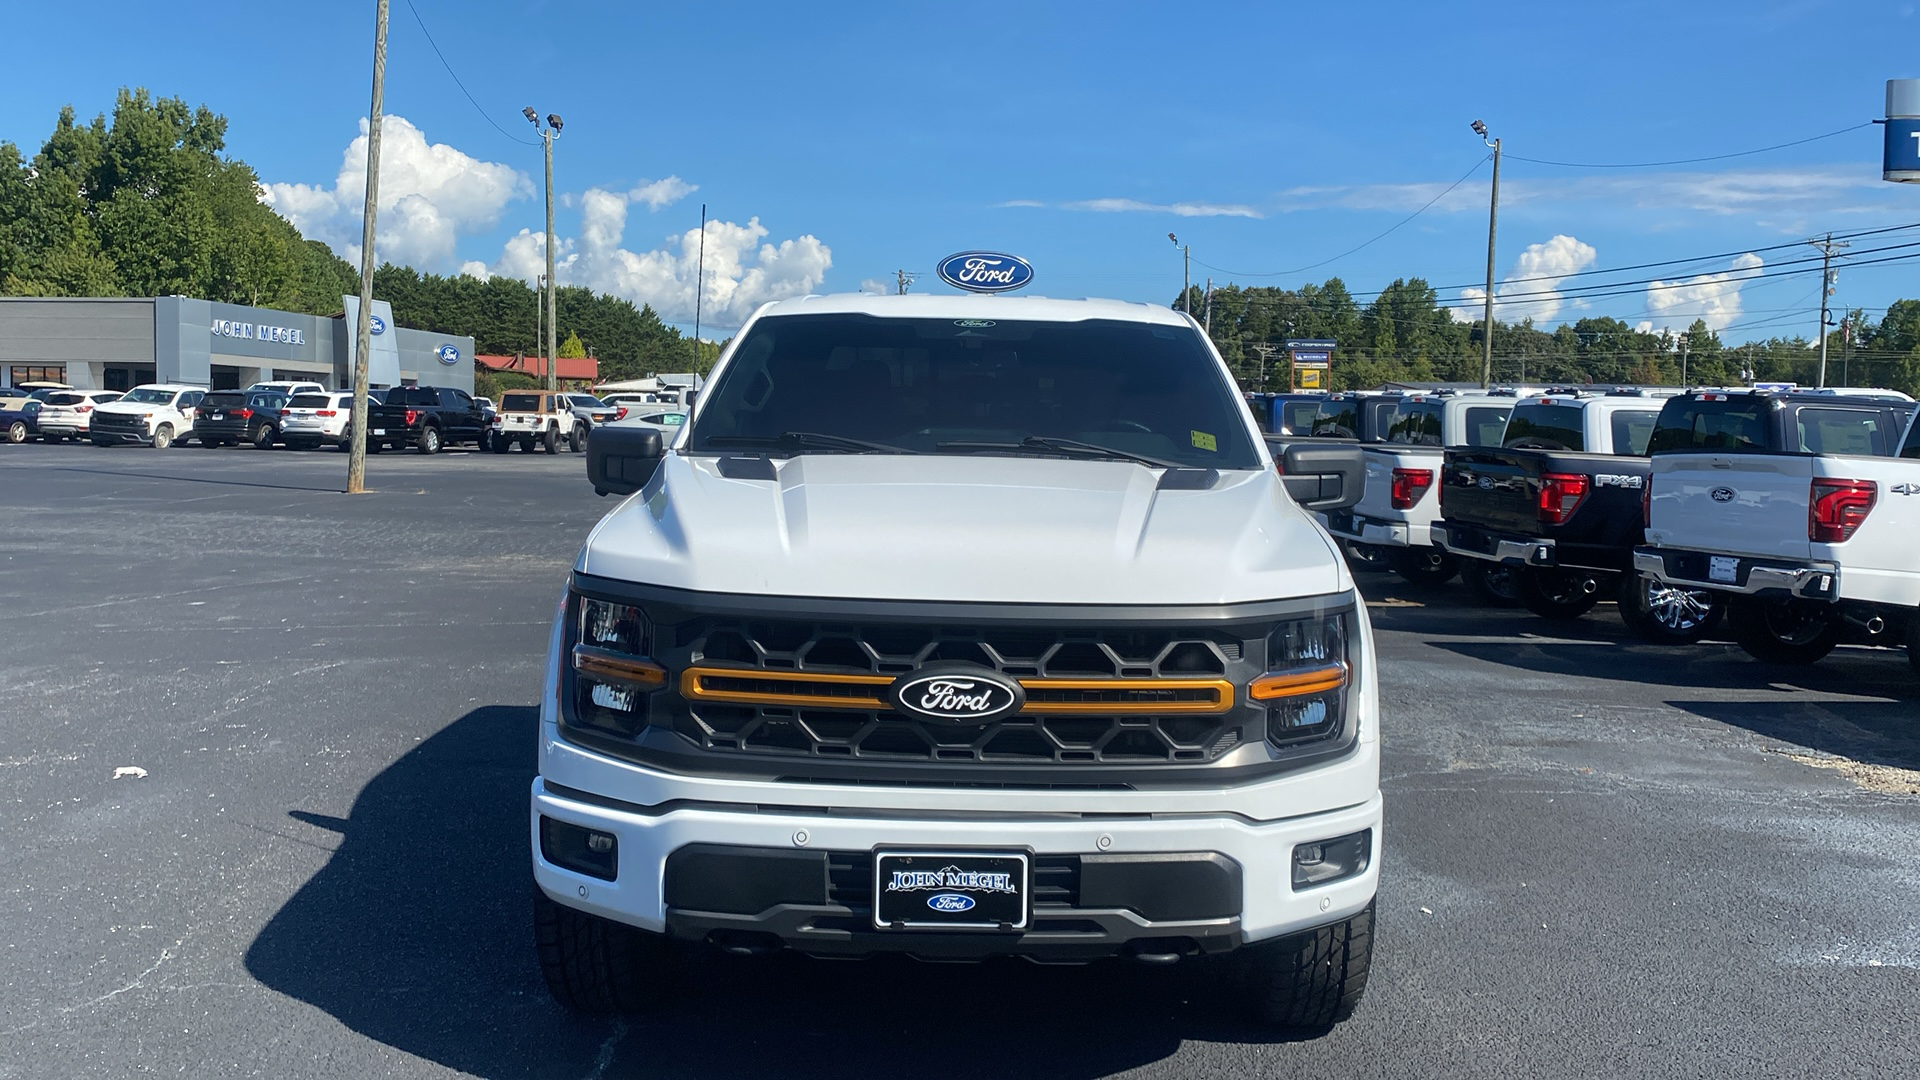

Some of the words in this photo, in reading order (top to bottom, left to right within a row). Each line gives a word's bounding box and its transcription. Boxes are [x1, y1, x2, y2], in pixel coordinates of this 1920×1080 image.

[958, 257, 1017, 284] Ford
[960, 319, 989, 327] Ford
[211, 319, 253, 339] JOHN
[257, 324, 306, 345] MEGEL
[443, 347, 458, 361] Ford
[1595, 474, 1643, 488] FX4
[920, 680, 993, 711] Ford
[888, 871, 945, 890] JOHN
[945, 871, 1016, 892] MEGEL
[935, 896, 967, 909] Ford
